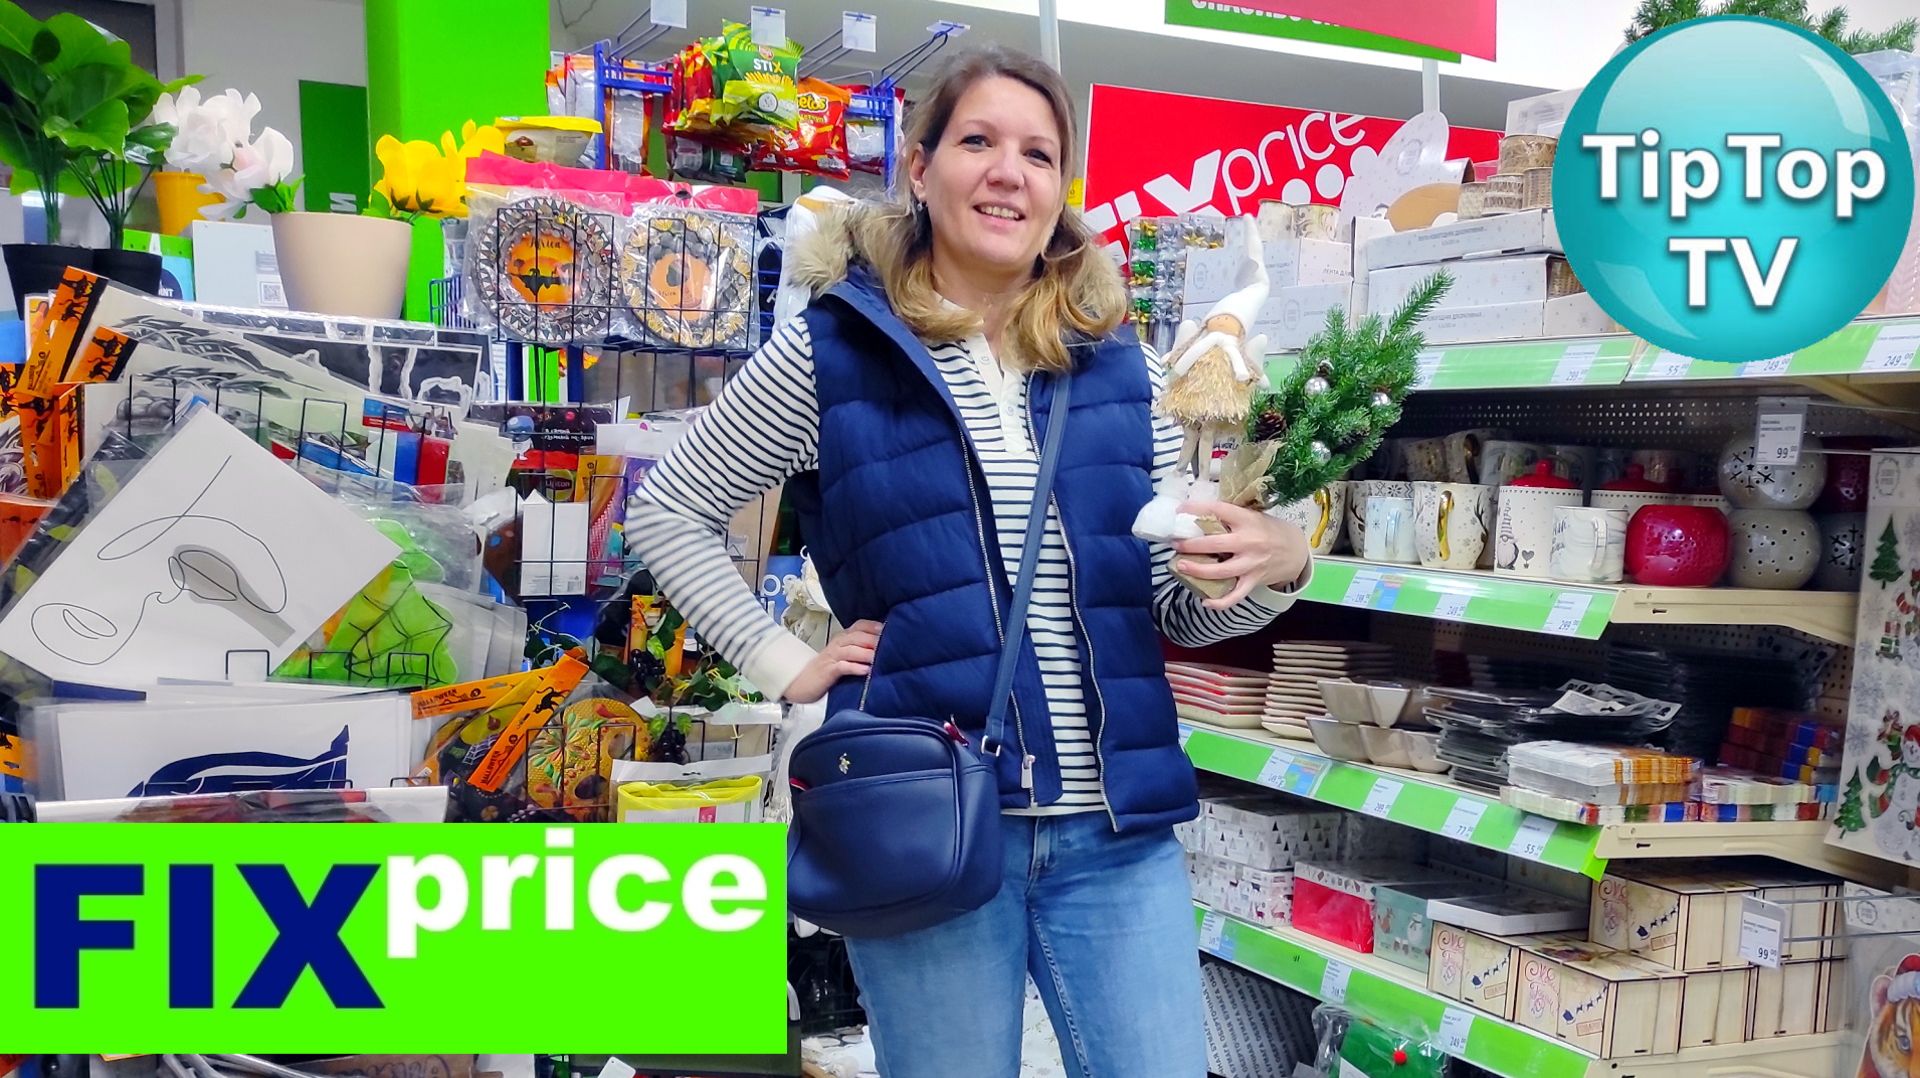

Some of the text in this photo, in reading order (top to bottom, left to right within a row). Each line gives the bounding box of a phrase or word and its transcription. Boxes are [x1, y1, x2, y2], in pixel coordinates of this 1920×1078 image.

[798, 91, 826, 110] etos
[1222, 112, 1367, 215] price
[1884, 355, 1901, 367] 249
[1776, 447, 1789, 459] 99
[1758, 947, 1769, 960] 99
